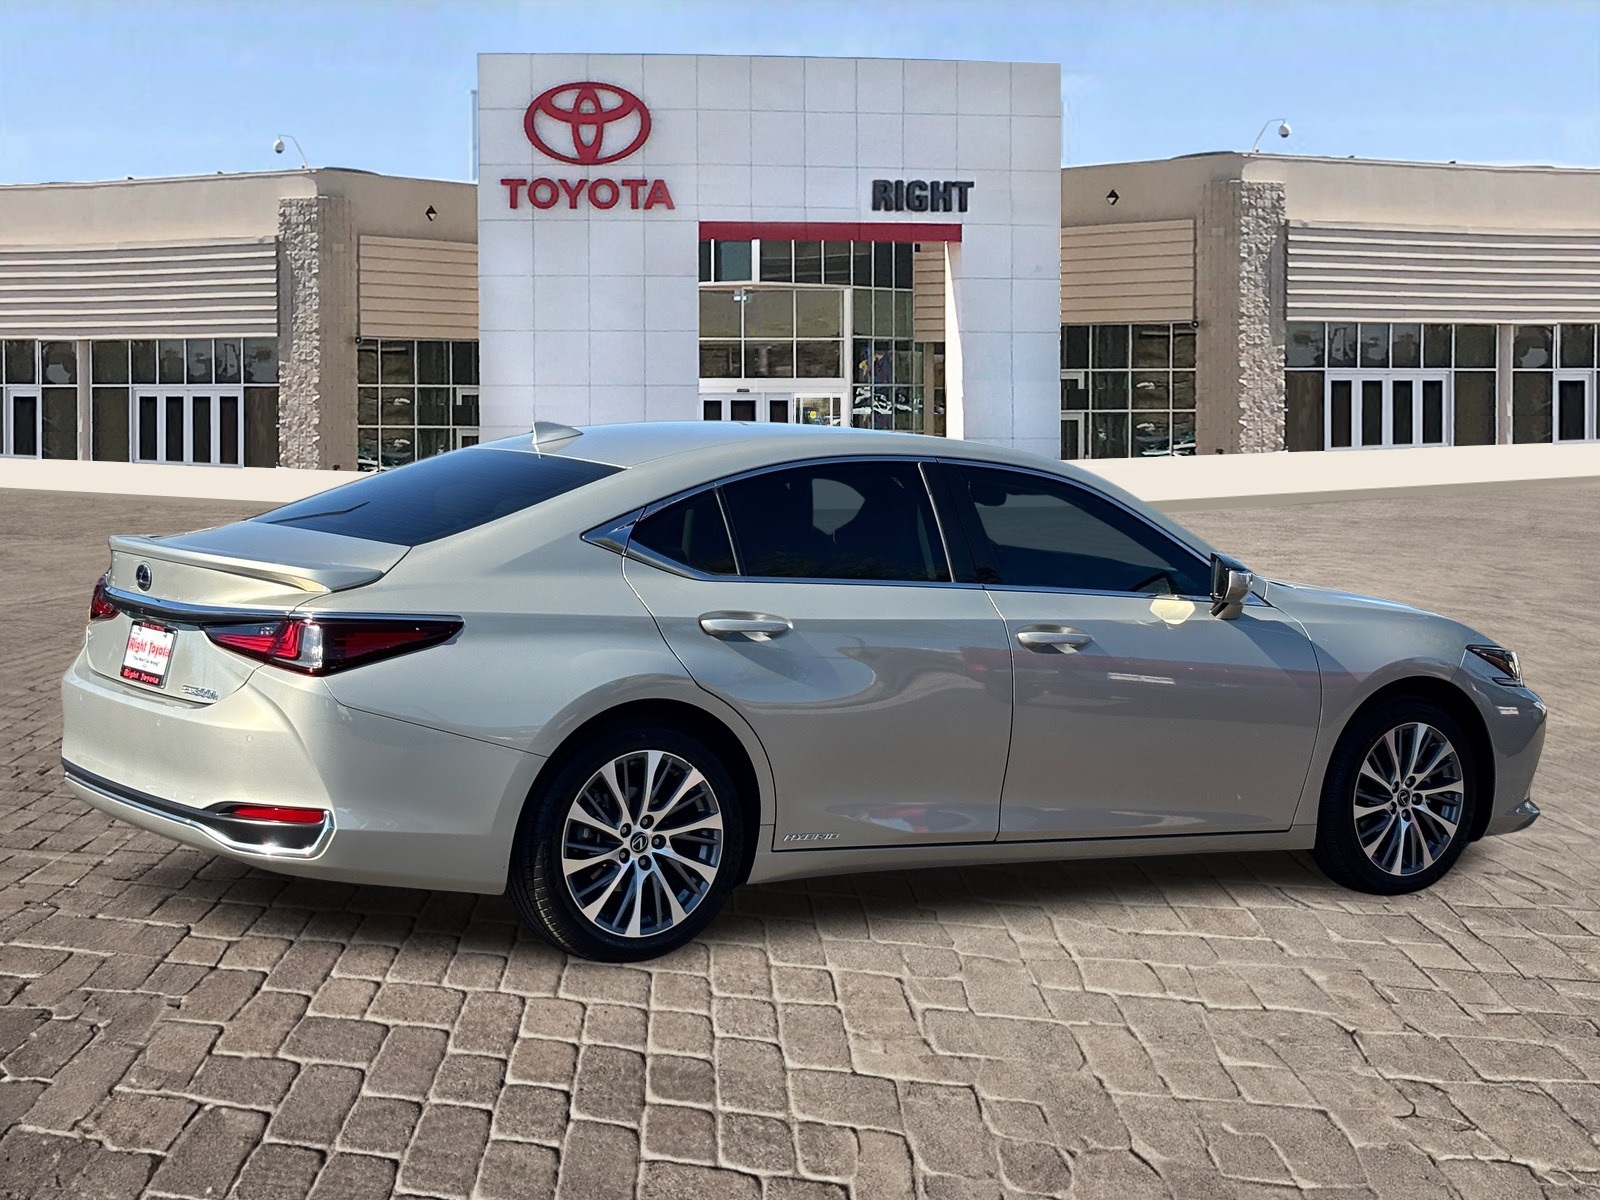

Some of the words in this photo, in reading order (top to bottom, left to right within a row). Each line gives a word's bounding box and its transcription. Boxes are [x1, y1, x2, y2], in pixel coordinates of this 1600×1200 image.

[500, 177, 675, 210] TOYOTA
[872, 179, 975, 212] RIGHT
[129, 638, 147, 653] Right
[148, 642, 171, 658] Toyota
[124, 669, 139, 679] Right
[141, 673, 159, 684] Toyota
